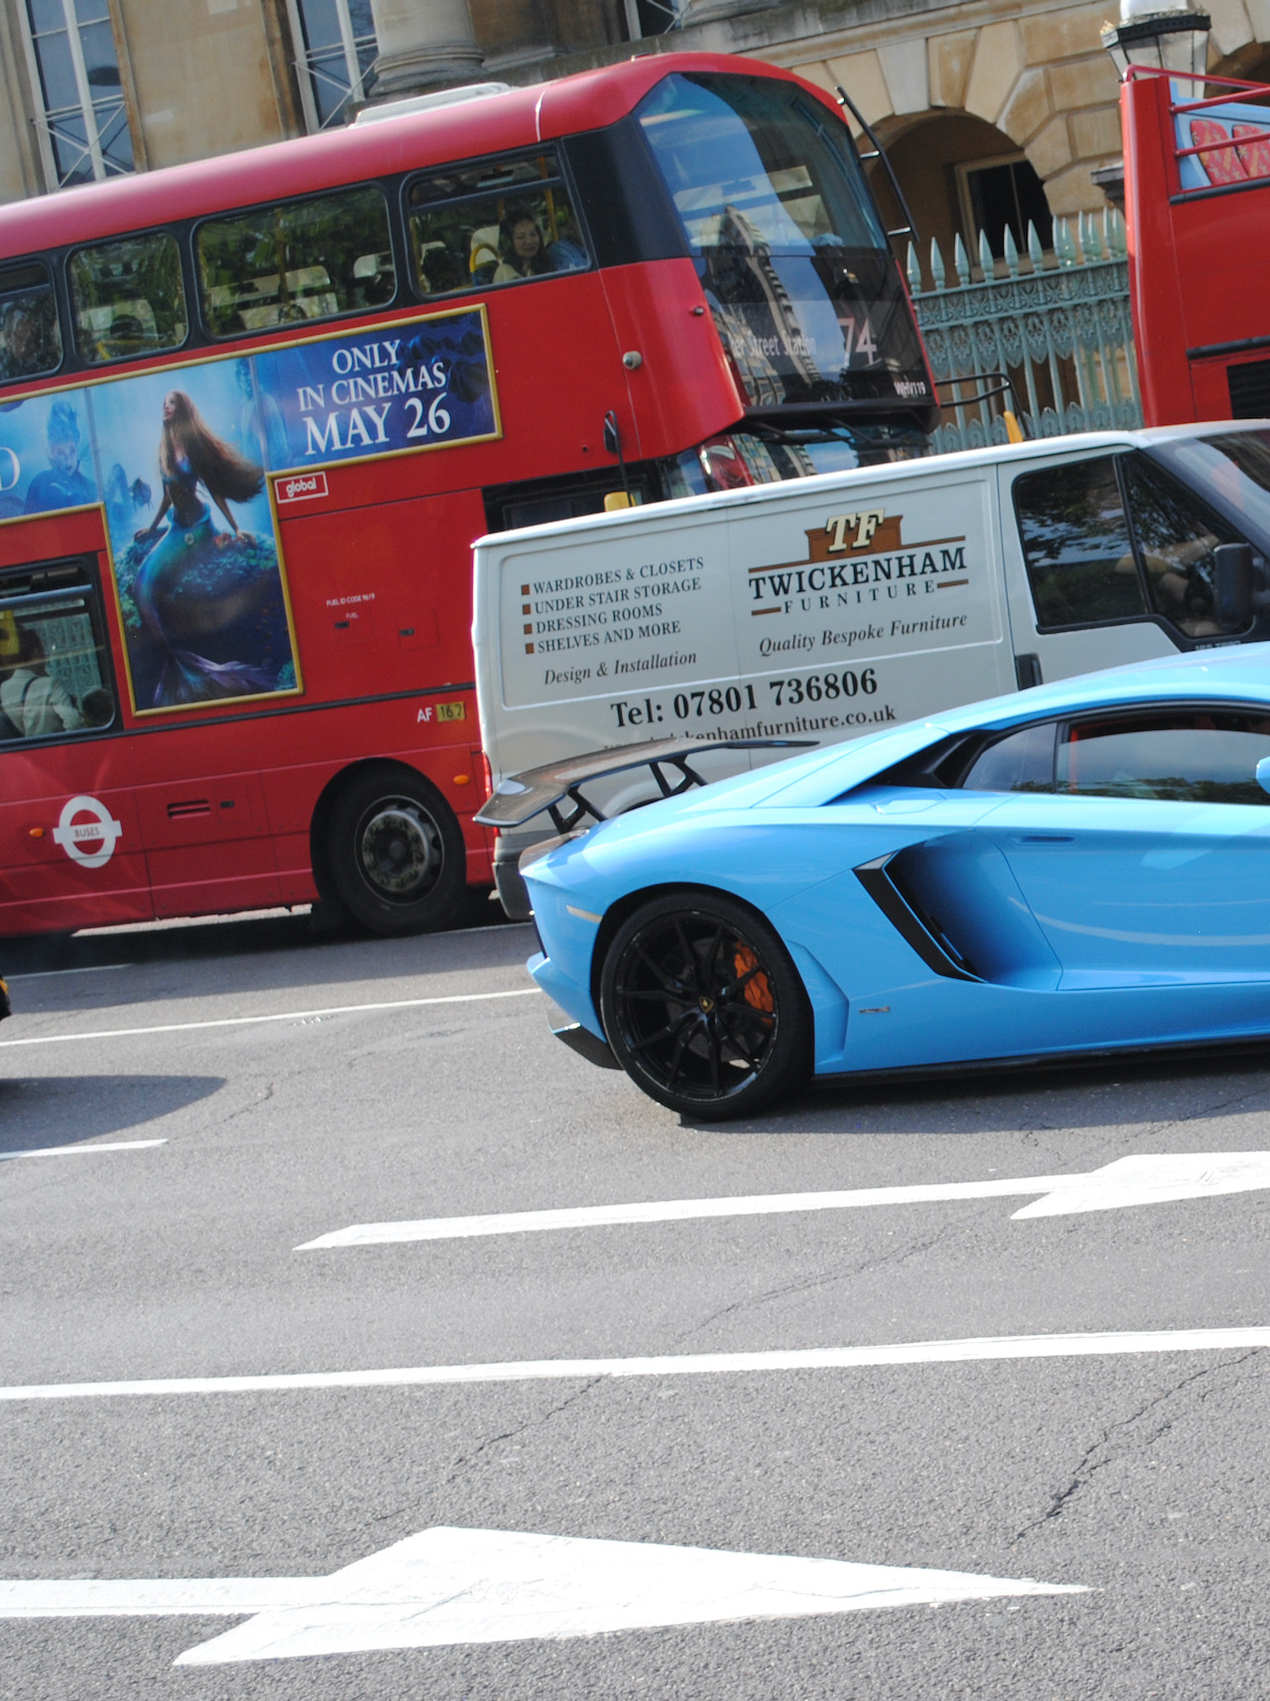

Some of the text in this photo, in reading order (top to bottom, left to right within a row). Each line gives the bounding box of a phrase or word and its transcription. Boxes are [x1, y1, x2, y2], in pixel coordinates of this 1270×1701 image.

[332, 339, 401, 375] ONLY
[837, 317, 877, 367] 74
[297, 362, 447, 412] IN CINEMAS
[303, 392, 451, 456] MAY 26
[286, 477, 317, 498] global
[825, 508, 886, 554] TF
[534, 557, 705, 595] WARDROBES & CLOSETS
[748, 547, 968, 600] TWICKENHAM
[535, 577, 702, 614] UNDER STAIR STORAGE
[784, 580, 936, 614] FURNITURE
[536, 603, 663, 634] DRESSING ROOMS
[538, 620, 682, 654] SHELVES AND MORE
[759, 614, 968, 657] Quality Bespoke Furniture
[544, 651, 698, 685] Design & Installation
[417, 707, 433, 722] AF
[611, 668, 878, 727] Tel: 07801 736806
[75, 826, 100, 838] BUSES
